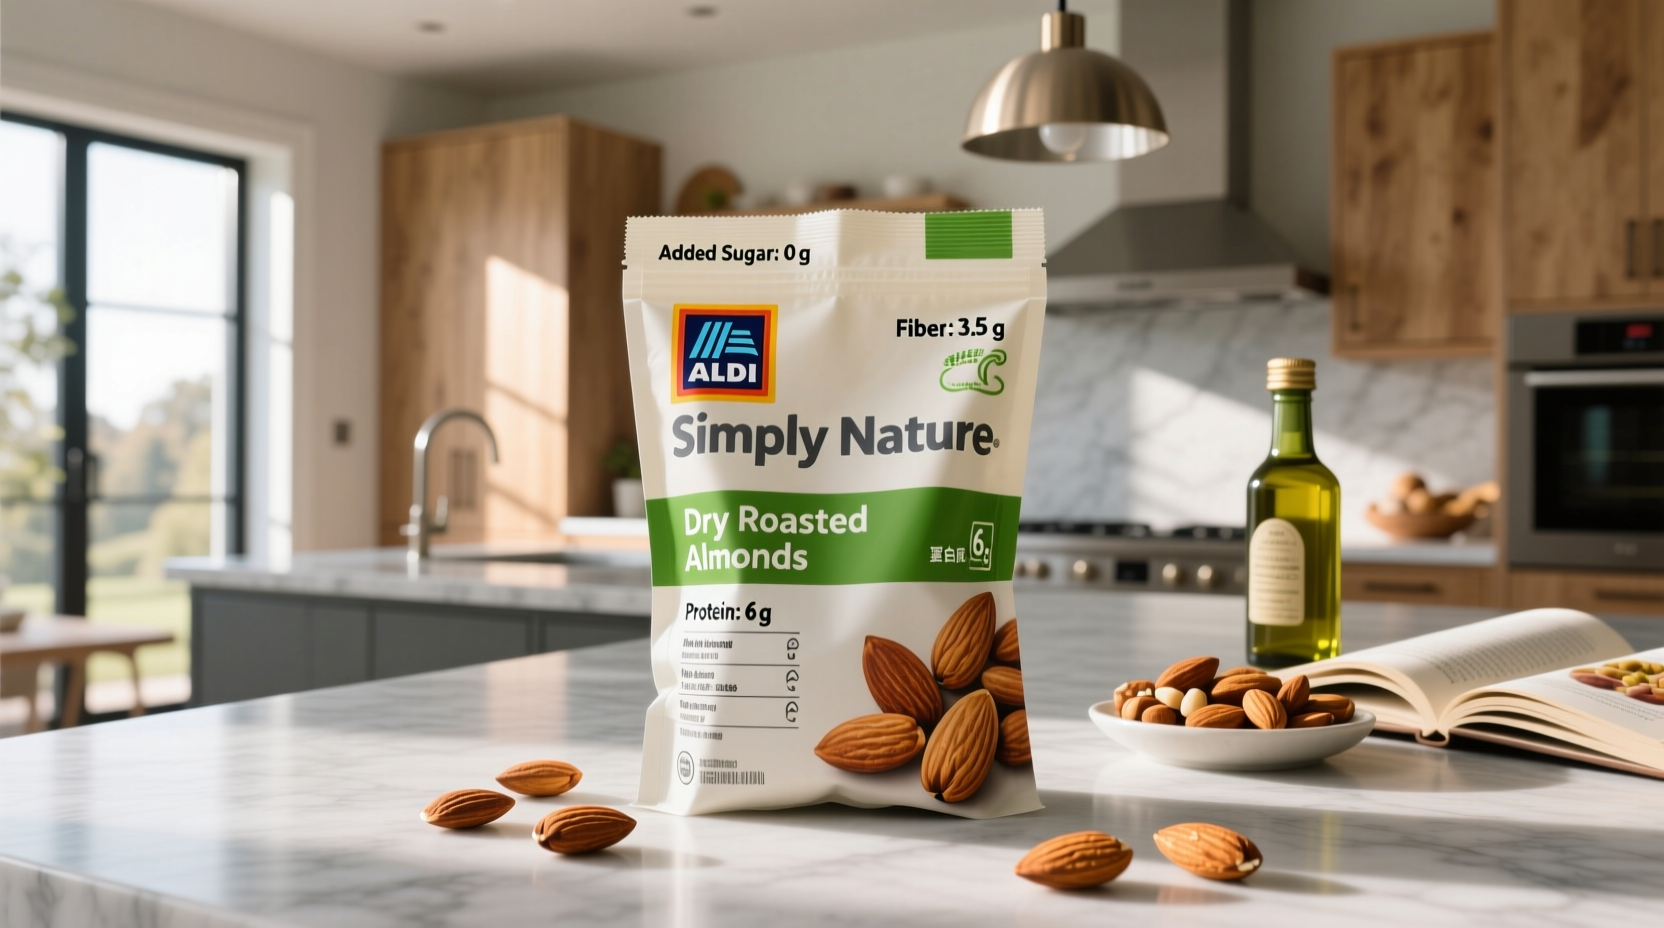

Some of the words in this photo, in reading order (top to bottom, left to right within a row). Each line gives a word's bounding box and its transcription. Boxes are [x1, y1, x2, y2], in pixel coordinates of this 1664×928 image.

[658, 244, 717, 262] Added
[721, 244, 780, 266] Sugar:
[783, 244, 796, 262] 0
[799, 247, 811, 265] g
[896, 317, 954, 338] Fiber:
[957, 316, 989, 337] 3.5
[992, 324, 1005, 342] g
[688, 362, 757, 383] ALDI
[672, 411, 829, 468] Simply
[684, 508, 730, 541] Dry
[738, 504, 868, 535] Roasted
[684, 542, 808, 572] Almonds
[685, 602, 741, 622] Protein:
[744, 601, 757, 621] 6
[758, 606, 772, 626] g
